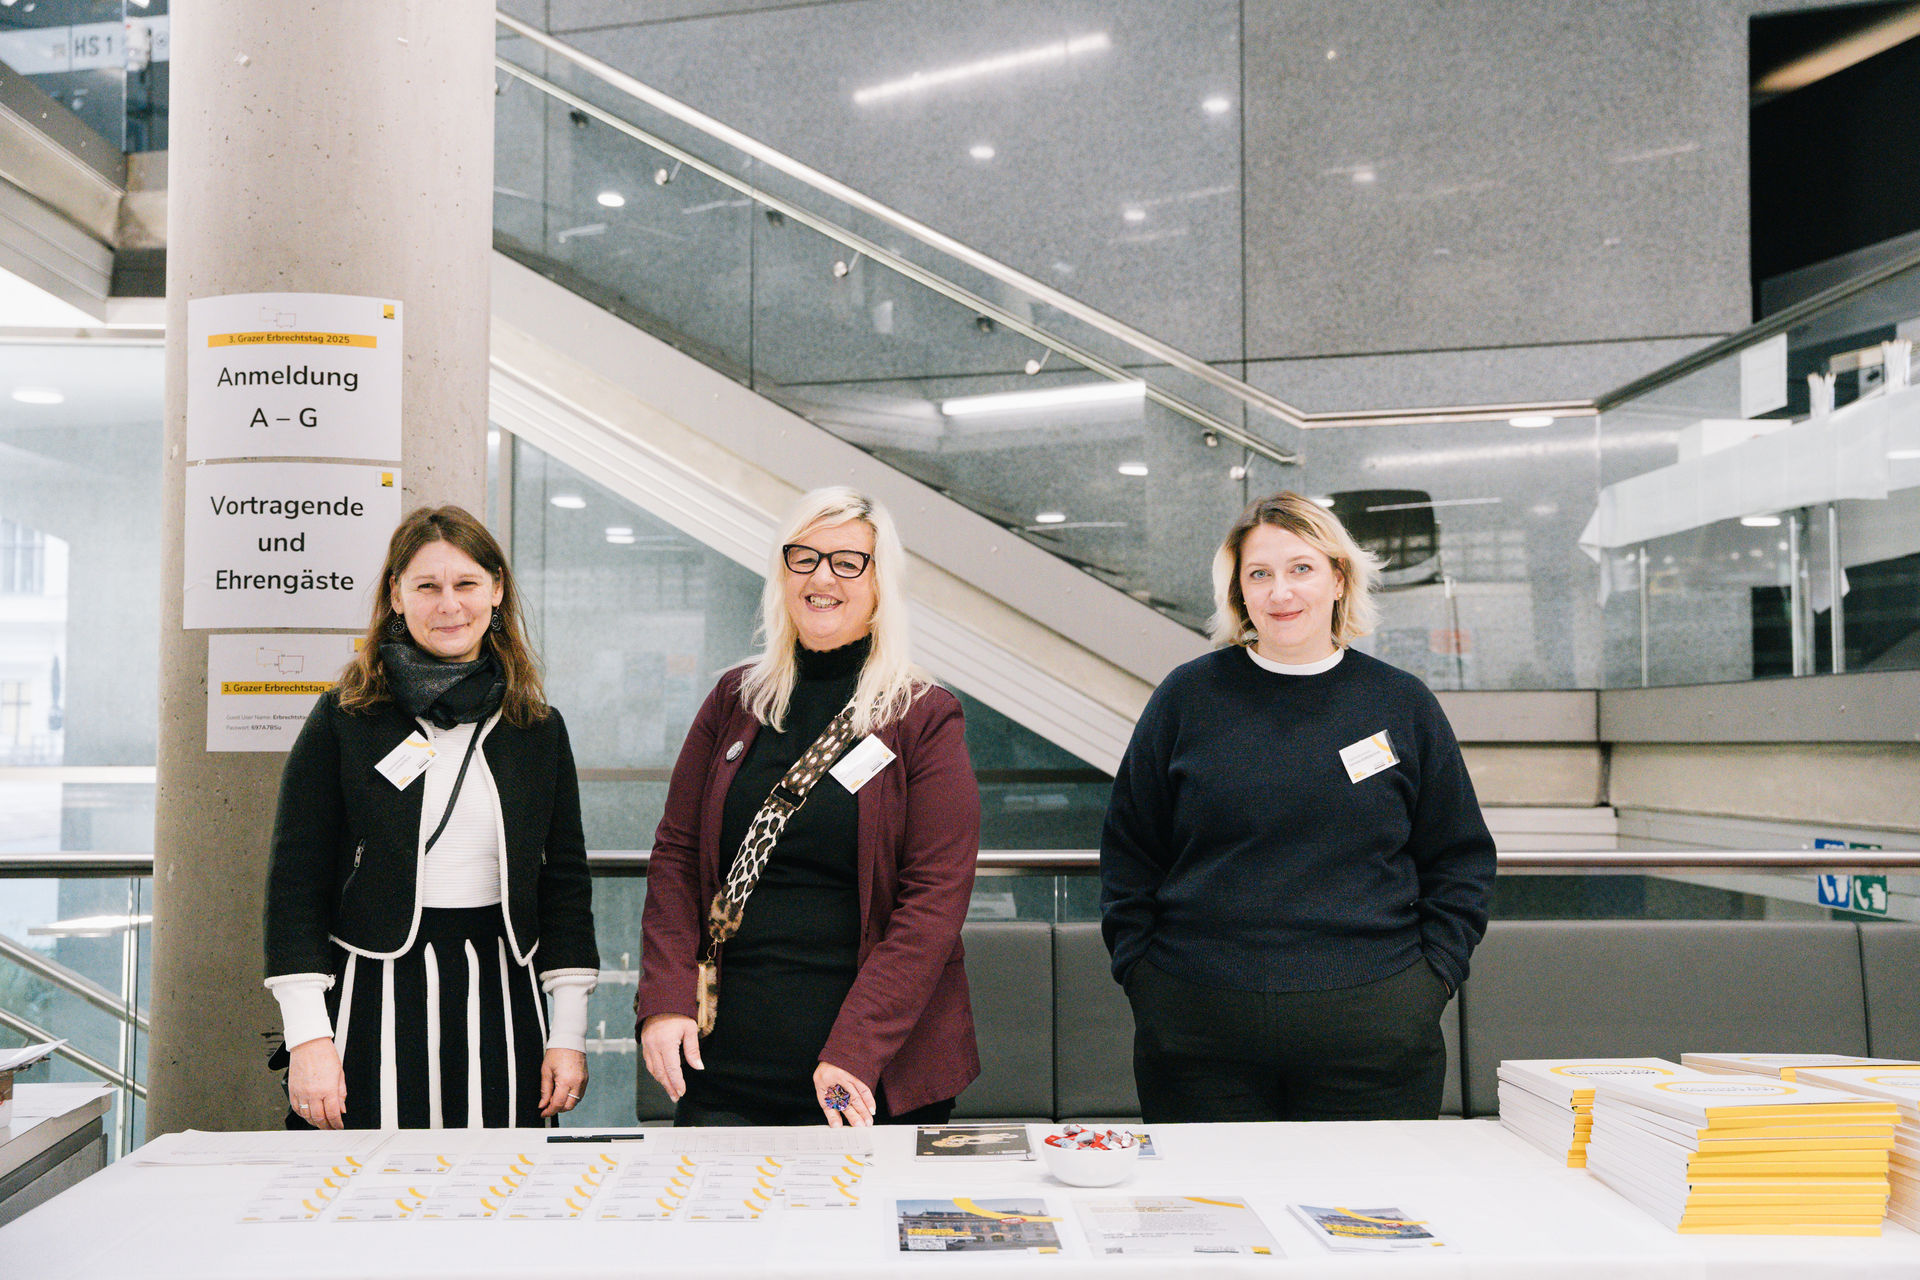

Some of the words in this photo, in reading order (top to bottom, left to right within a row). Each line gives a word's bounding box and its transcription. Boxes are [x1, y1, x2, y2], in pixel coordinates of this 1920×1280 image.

[75, 35, 99, 57] HS
[106, 36, 113, 56] 1
[229, 335, 236, 344] 3.
[237, 334, 265, 344] Grazer
[266, 333, 324, 344] Erbrechtstag
[326, 335, 350, 344] 2025
[217, 365, 359, 392] Anmeldung
[250, 408, 269, 427] A
[299, 408, 317, 427] G
[210, 495, 364, 519] Vortragende
[258, 532, 305, 552] und
[216, 569, 354, 594] Ehrengäste
[224, 684, 232, 692] 3.
[233, 684, 262, 692] Grazer
[264, 684, 325, 693] Erbrechtstag
